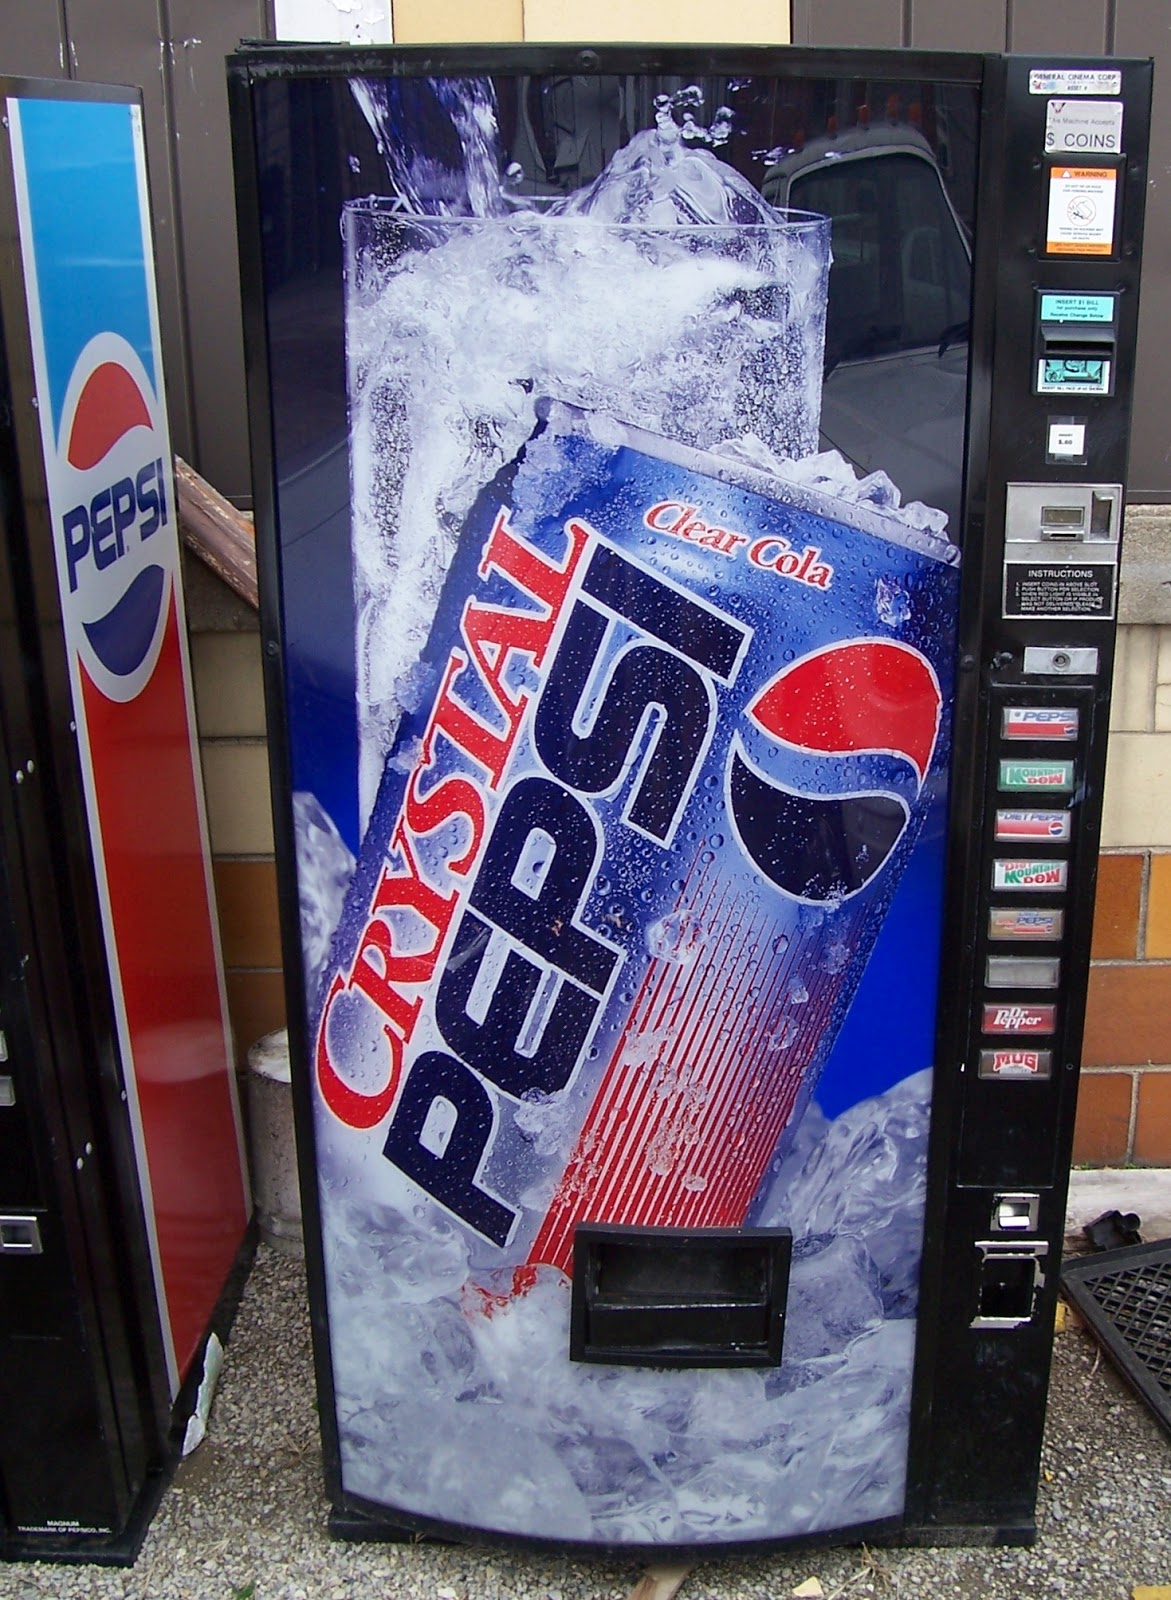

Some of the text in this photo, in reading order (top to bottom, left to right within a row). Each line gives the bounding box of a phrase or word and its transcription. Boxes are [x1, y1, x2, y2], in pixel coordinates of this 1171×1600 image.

[1064, 133, 1115, 148] COINS
[62, 457, 168, 594] PEPSI
[644, 499, 835, 592] Clear Cola
[1028, 569, 1093, 578] INSTRUCTIONS
[1030, 813, 1063, 821] PEPSI
[383, 540, 752, 1247] PEPSI
[1017, 916, 1053, 924] PEPSI
[993, 1010, 1042, 1029] Pepper
[1010, 1007, 1029, 1018] Dr
[993, 1051, 1038, 1071] MUG
